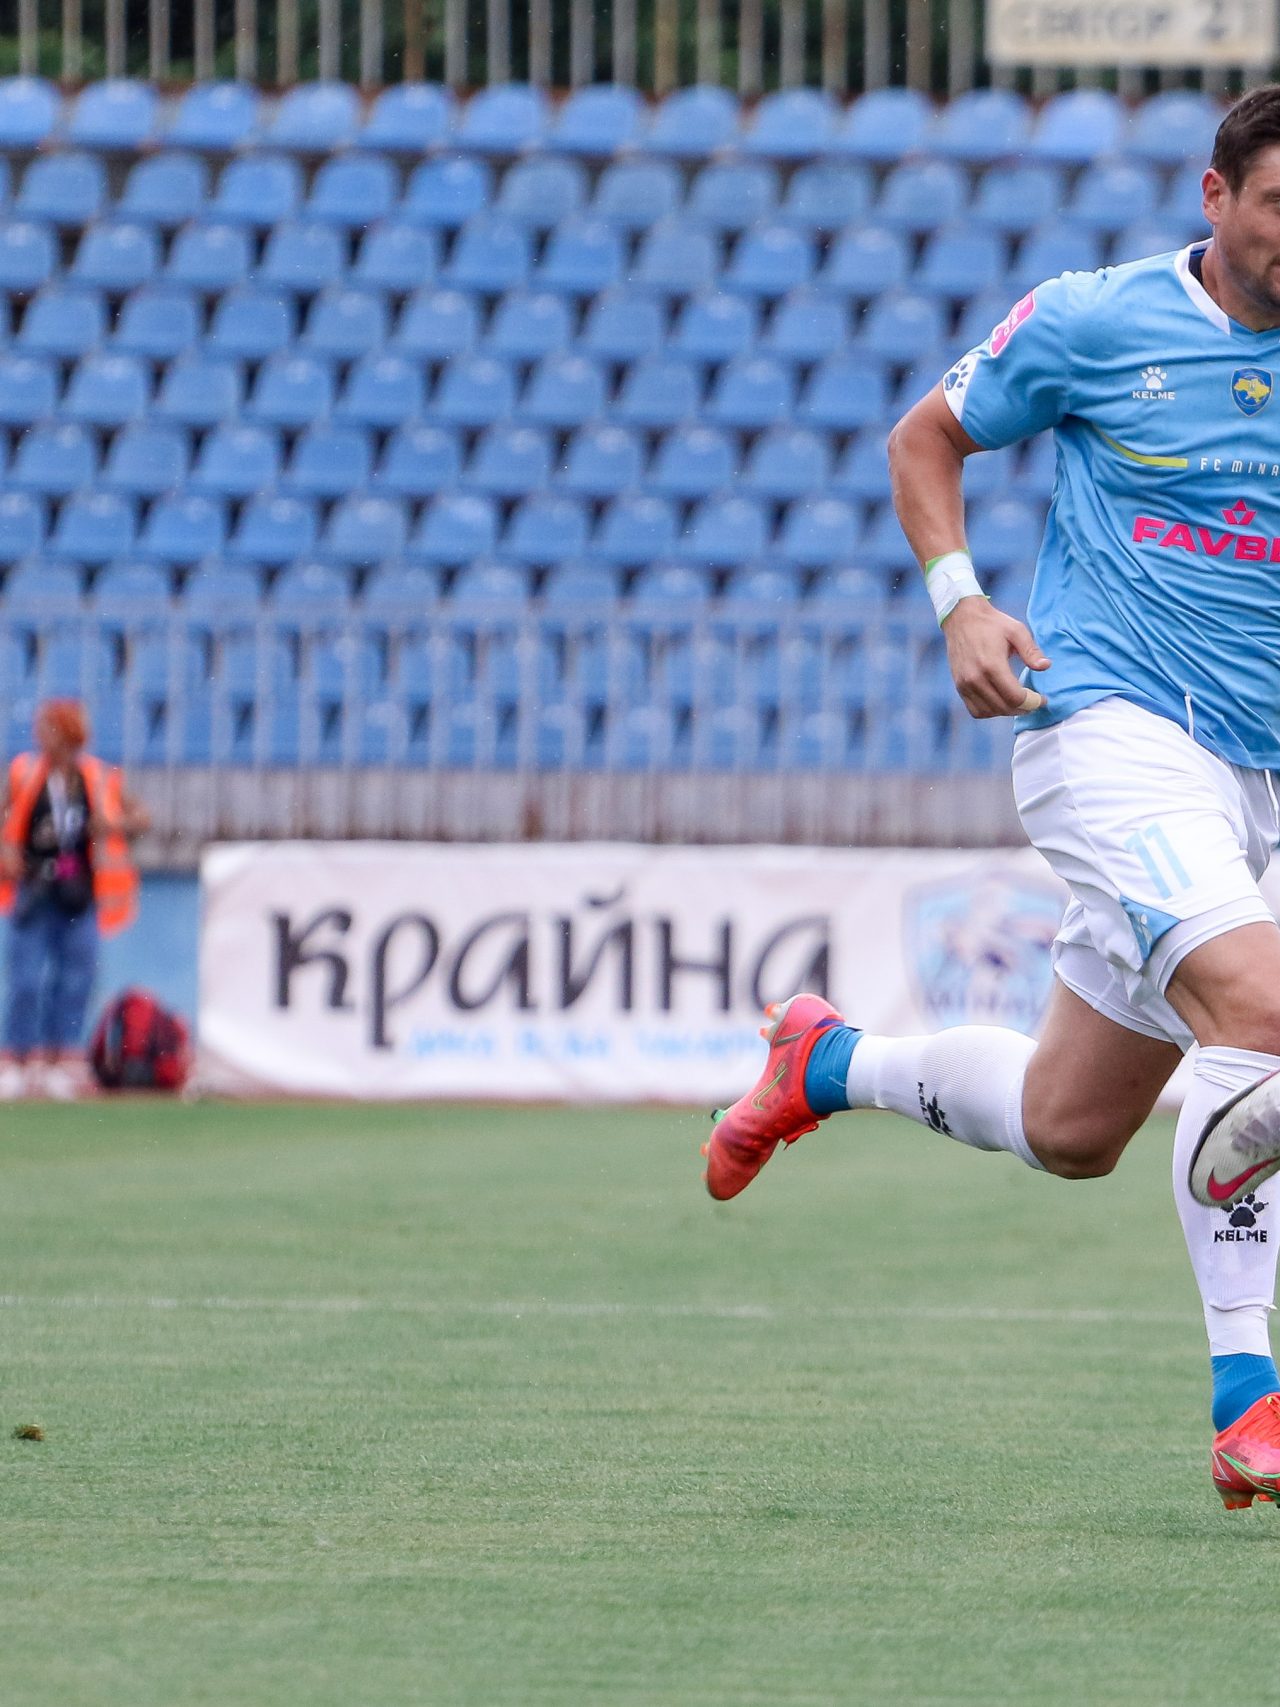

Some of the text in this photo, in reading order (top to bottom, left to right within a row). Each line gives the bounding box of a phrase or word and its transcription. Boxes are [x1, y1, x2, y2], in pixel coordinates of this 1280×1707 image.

[1132, 390, 1176, 400] KELME
[1200, 457, 1222, 471] FC
[1124, 821, 1194, 901] 11
[1213, 1230, 1268, 1243] KELME
